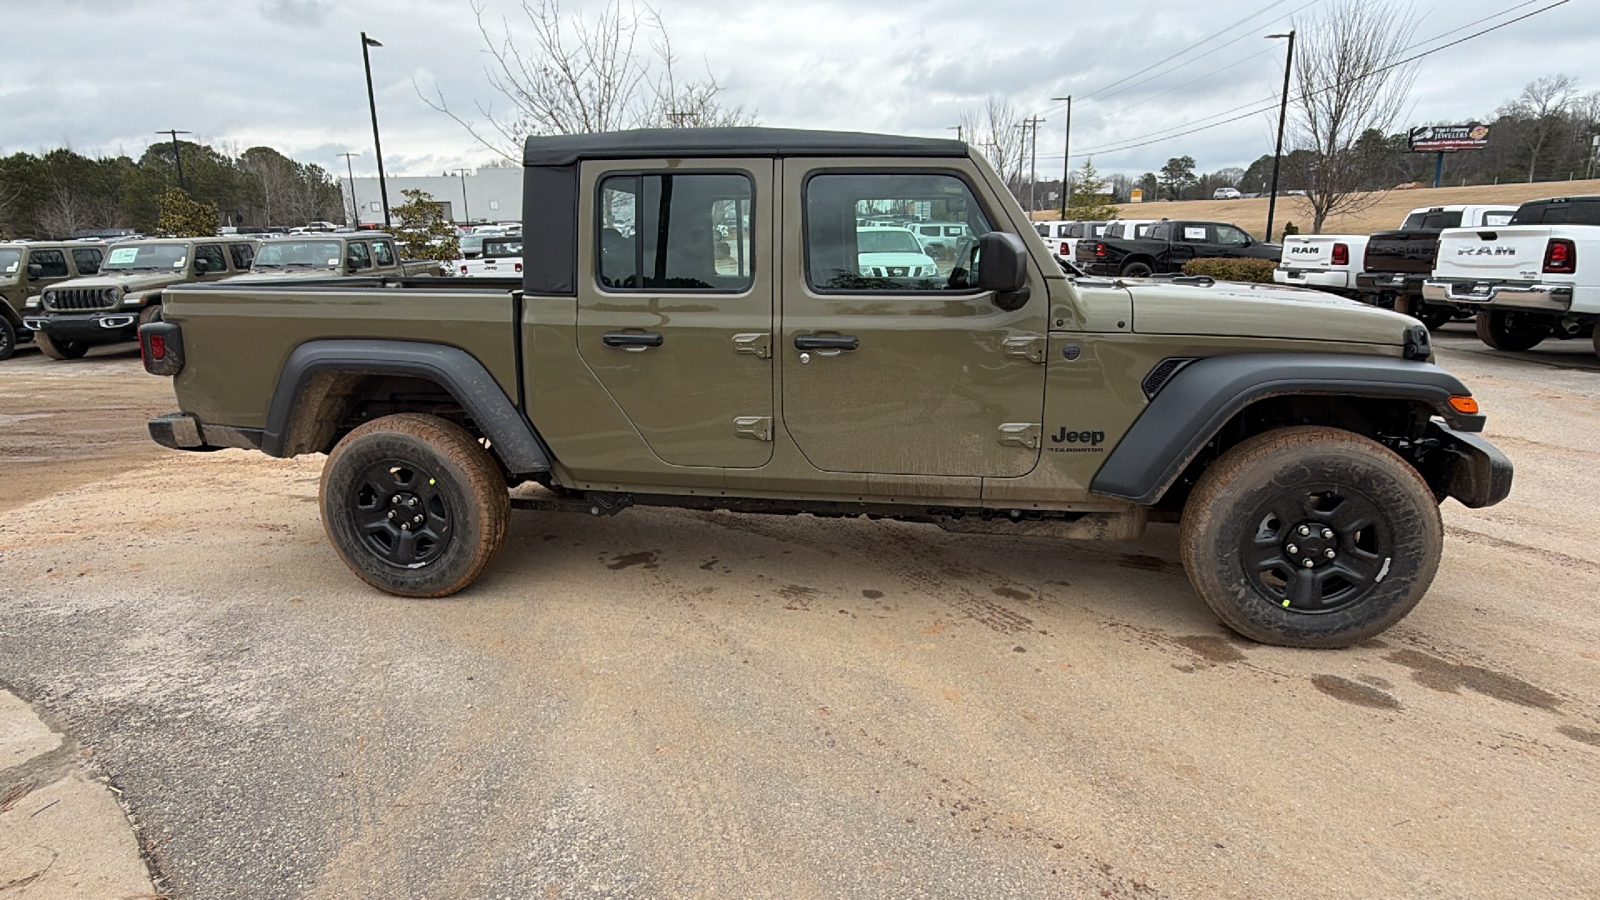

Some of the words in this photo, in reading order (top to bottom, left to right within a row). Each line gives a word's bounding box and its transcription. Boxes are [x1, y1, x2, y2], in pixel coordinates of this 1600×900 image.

[1434, 132, 1468, 140] JEWELERS
[1458, 246, 1516, 256] RAM
[1051, 426, 1105, 446] Jeep
